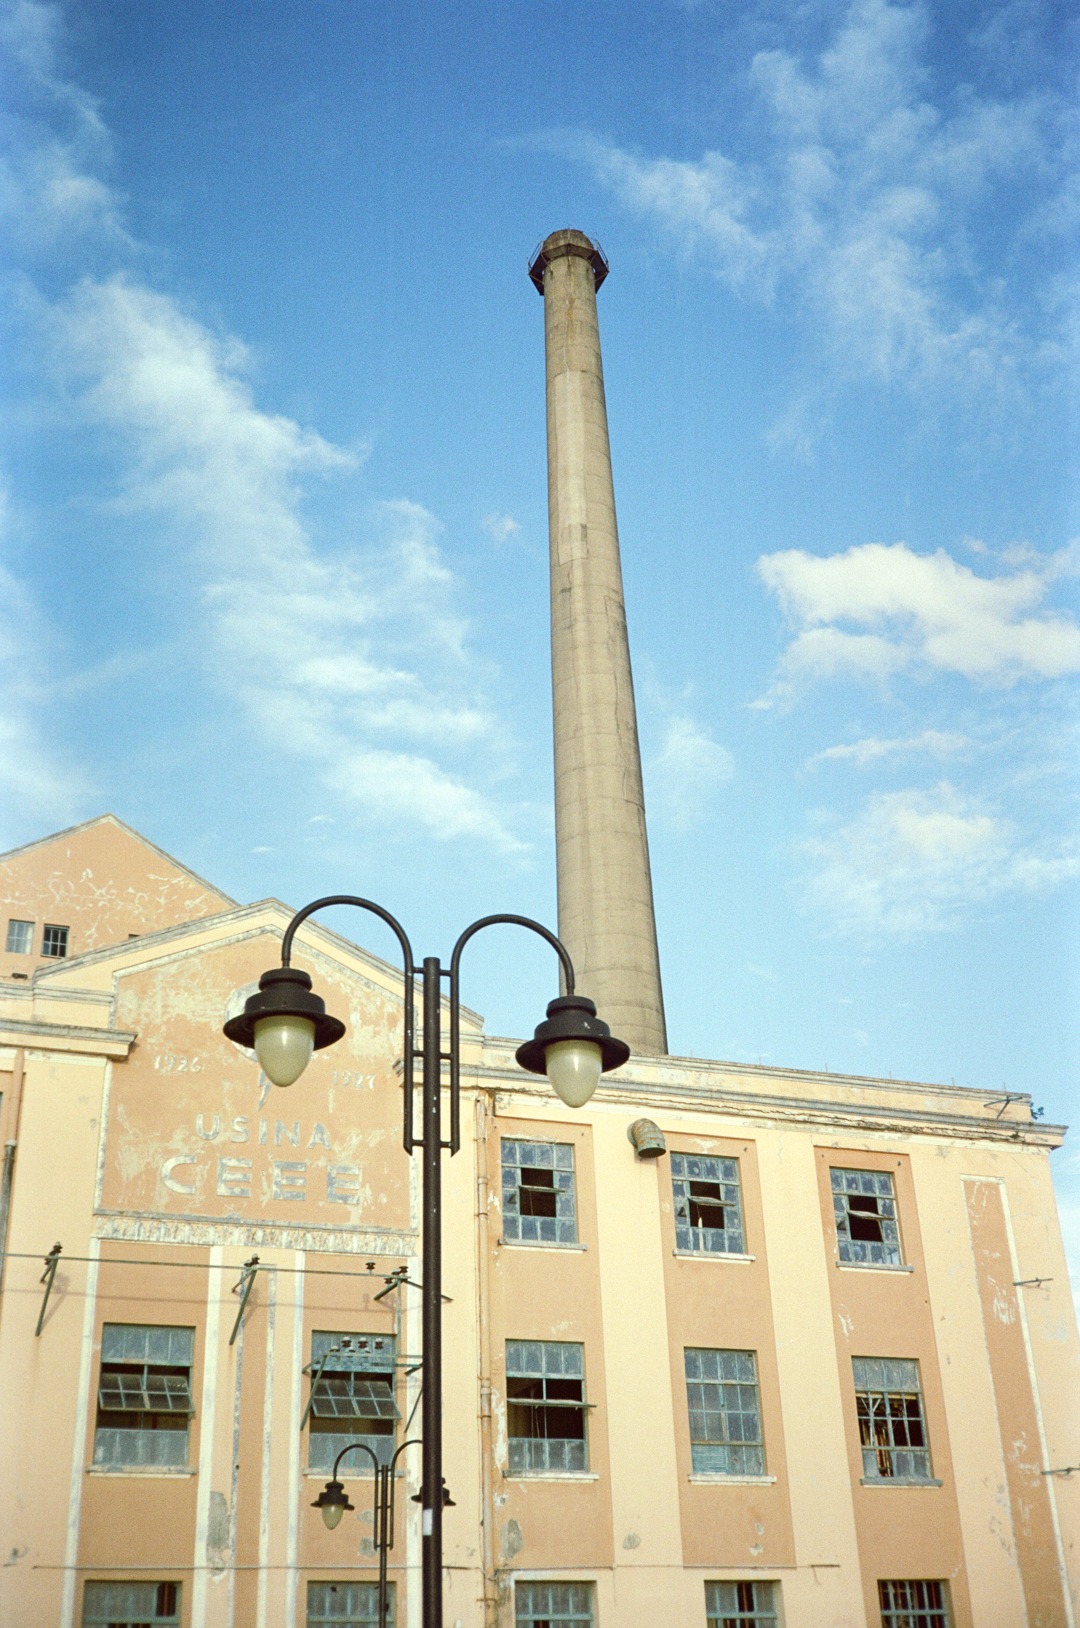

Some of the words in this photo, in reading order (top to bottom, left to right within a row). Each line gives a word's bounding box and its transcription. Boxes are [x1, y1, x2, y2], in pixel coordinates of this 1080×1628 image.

[153, 1053, 202, 1073] 1926
[195, 1113, 332, 1150] USINA
[161, 1154, 362, 1205] CEEE
